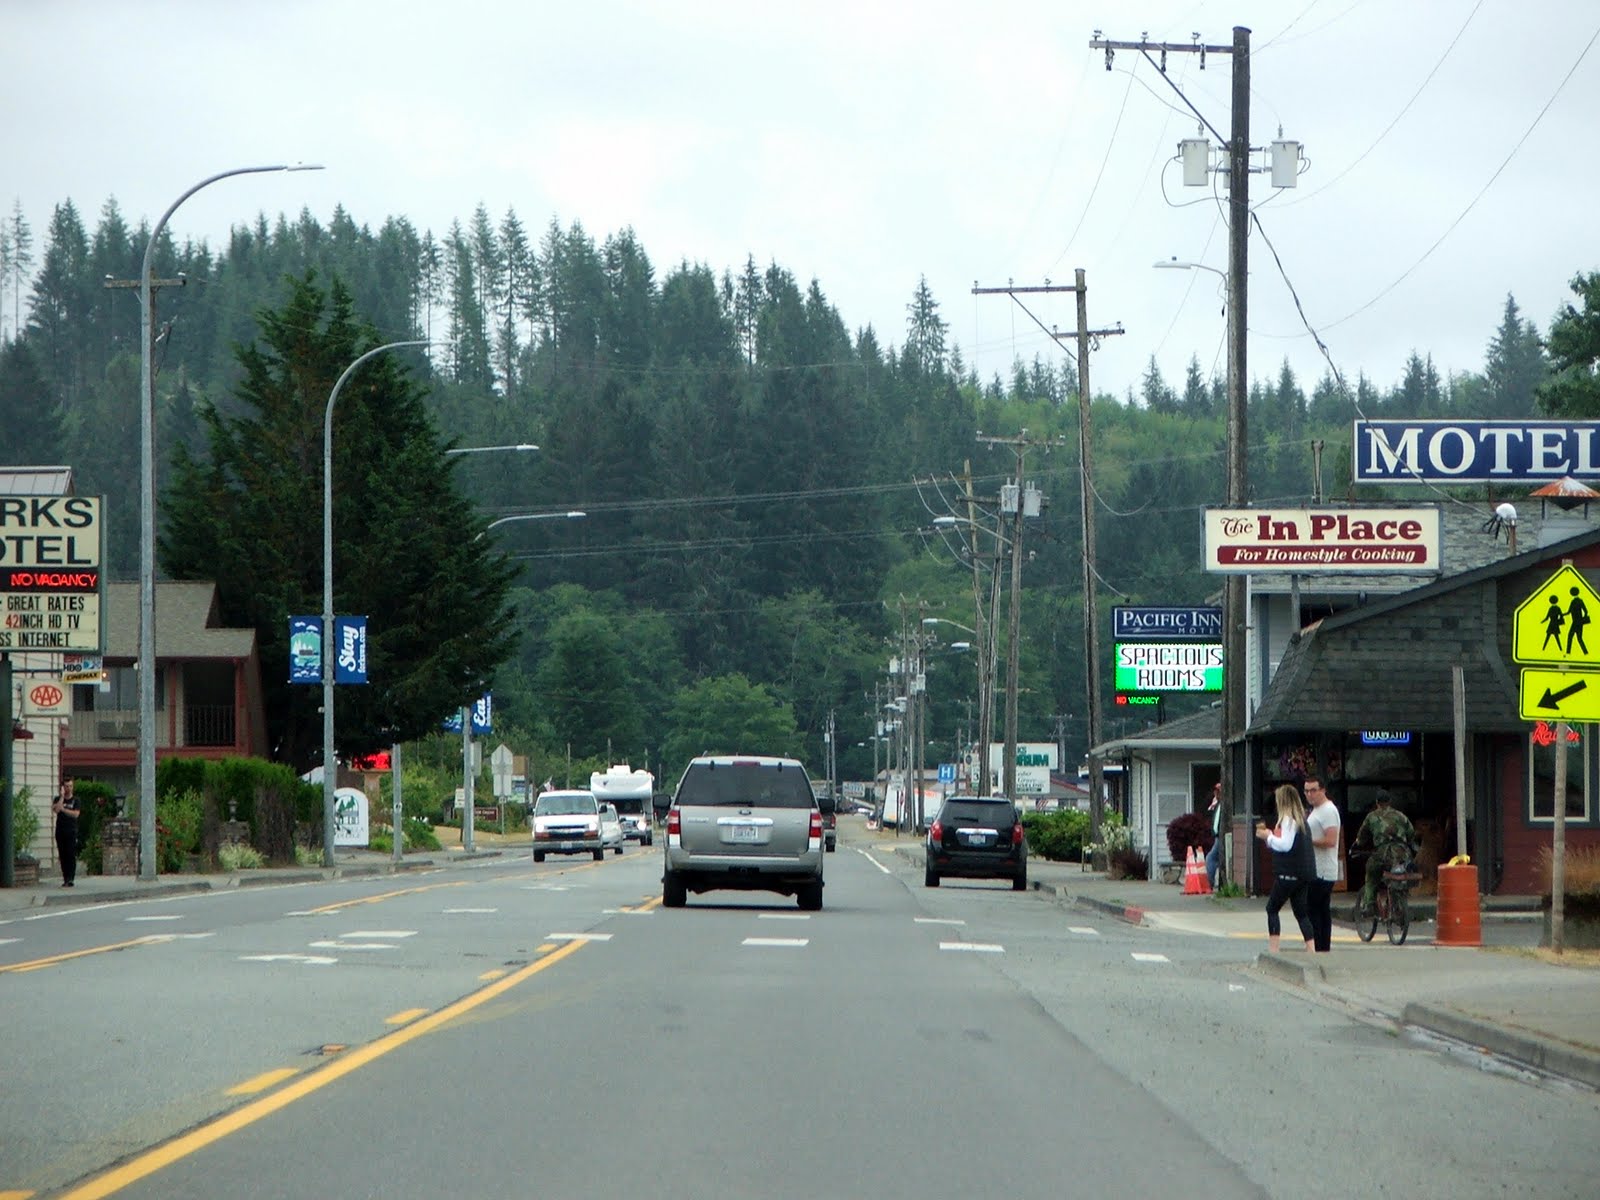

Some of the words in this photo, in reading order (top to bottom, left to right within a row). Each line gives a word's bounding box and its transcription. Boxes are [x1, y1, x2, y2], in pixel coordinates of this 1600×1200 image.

[1365, 427, 1600, 474] MOTEL
[0, 498, 93, 528] RKS
[1220, 517, 1254, 537] The
[1257, 515, 1299, 540] In
[1310, 515, 1422, 540] Place
[0, 535, 92, 564] TEL
[1233, 548, 1262, 561] For
[1265, 548, 1347, 563] Homestyle
[1351, 548, 1416, 562] Cooking
[10, 573, 34, 586] NO
[34, 573, 97, 586] VACANCY
[7, 596, 41, 611] GREAT
[47, 596, 84, 611] RATES
[48, 614, 62, 628] HD
[67, 614, 80, 628] TV
[1122, 611, 1187, 626] PACIFIC
[18, 632, 71, 647] INTERNET
[338, 625, 359, 673] Stay
[1120, 647, 1223, 666] SPACIOUS
[1138, 668, 1204, 687] ROOMS
[33, 686, 61, 706] AAA
[1115, 696, 1127, 704] NO
[1128, 696, 1160, 704] VACANCY
[941, 766, 951, 778] H
